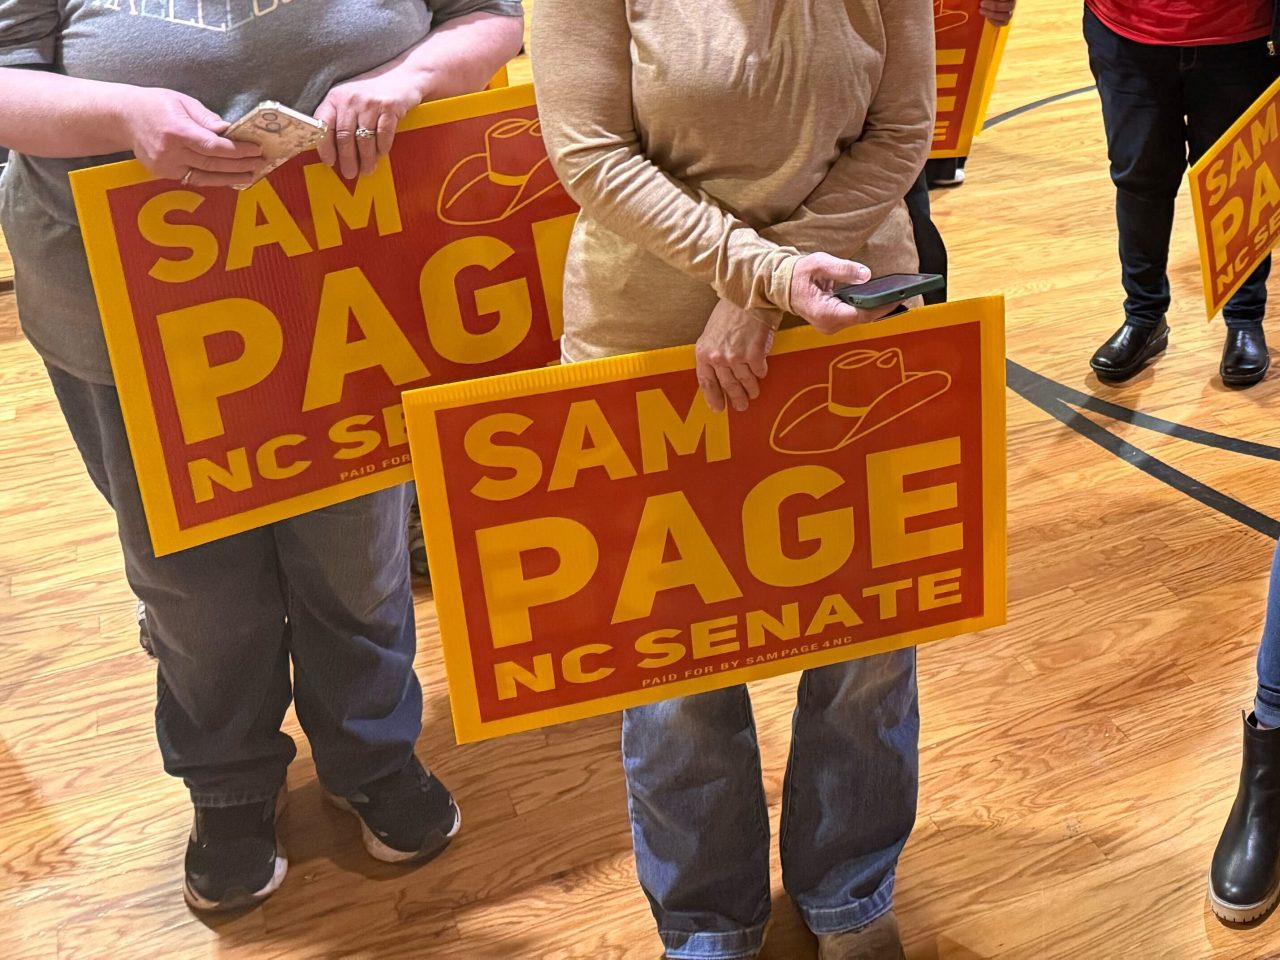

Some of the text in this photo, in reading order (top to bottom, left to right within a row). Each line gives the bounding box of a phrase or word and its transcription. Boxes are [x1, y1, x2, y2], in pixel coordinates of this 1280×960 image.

[1206, 102, 1278, 206] SAM
[136, 155, 403, 283] SAM
[1217, 246, 1249, 295] NC
[187, 434, 311, 503] NC
[340, 454, 410, 480] PAID FOR
[463, 386, 732, 501] SAM
[475, 436, 964, 649] PAGE
[493, 568, 963, 701] NC SENATE
[641, 673, 677, 688] PAID
[684, 665, 713, 678] FOR
[720, 659, 739, 671] BY
